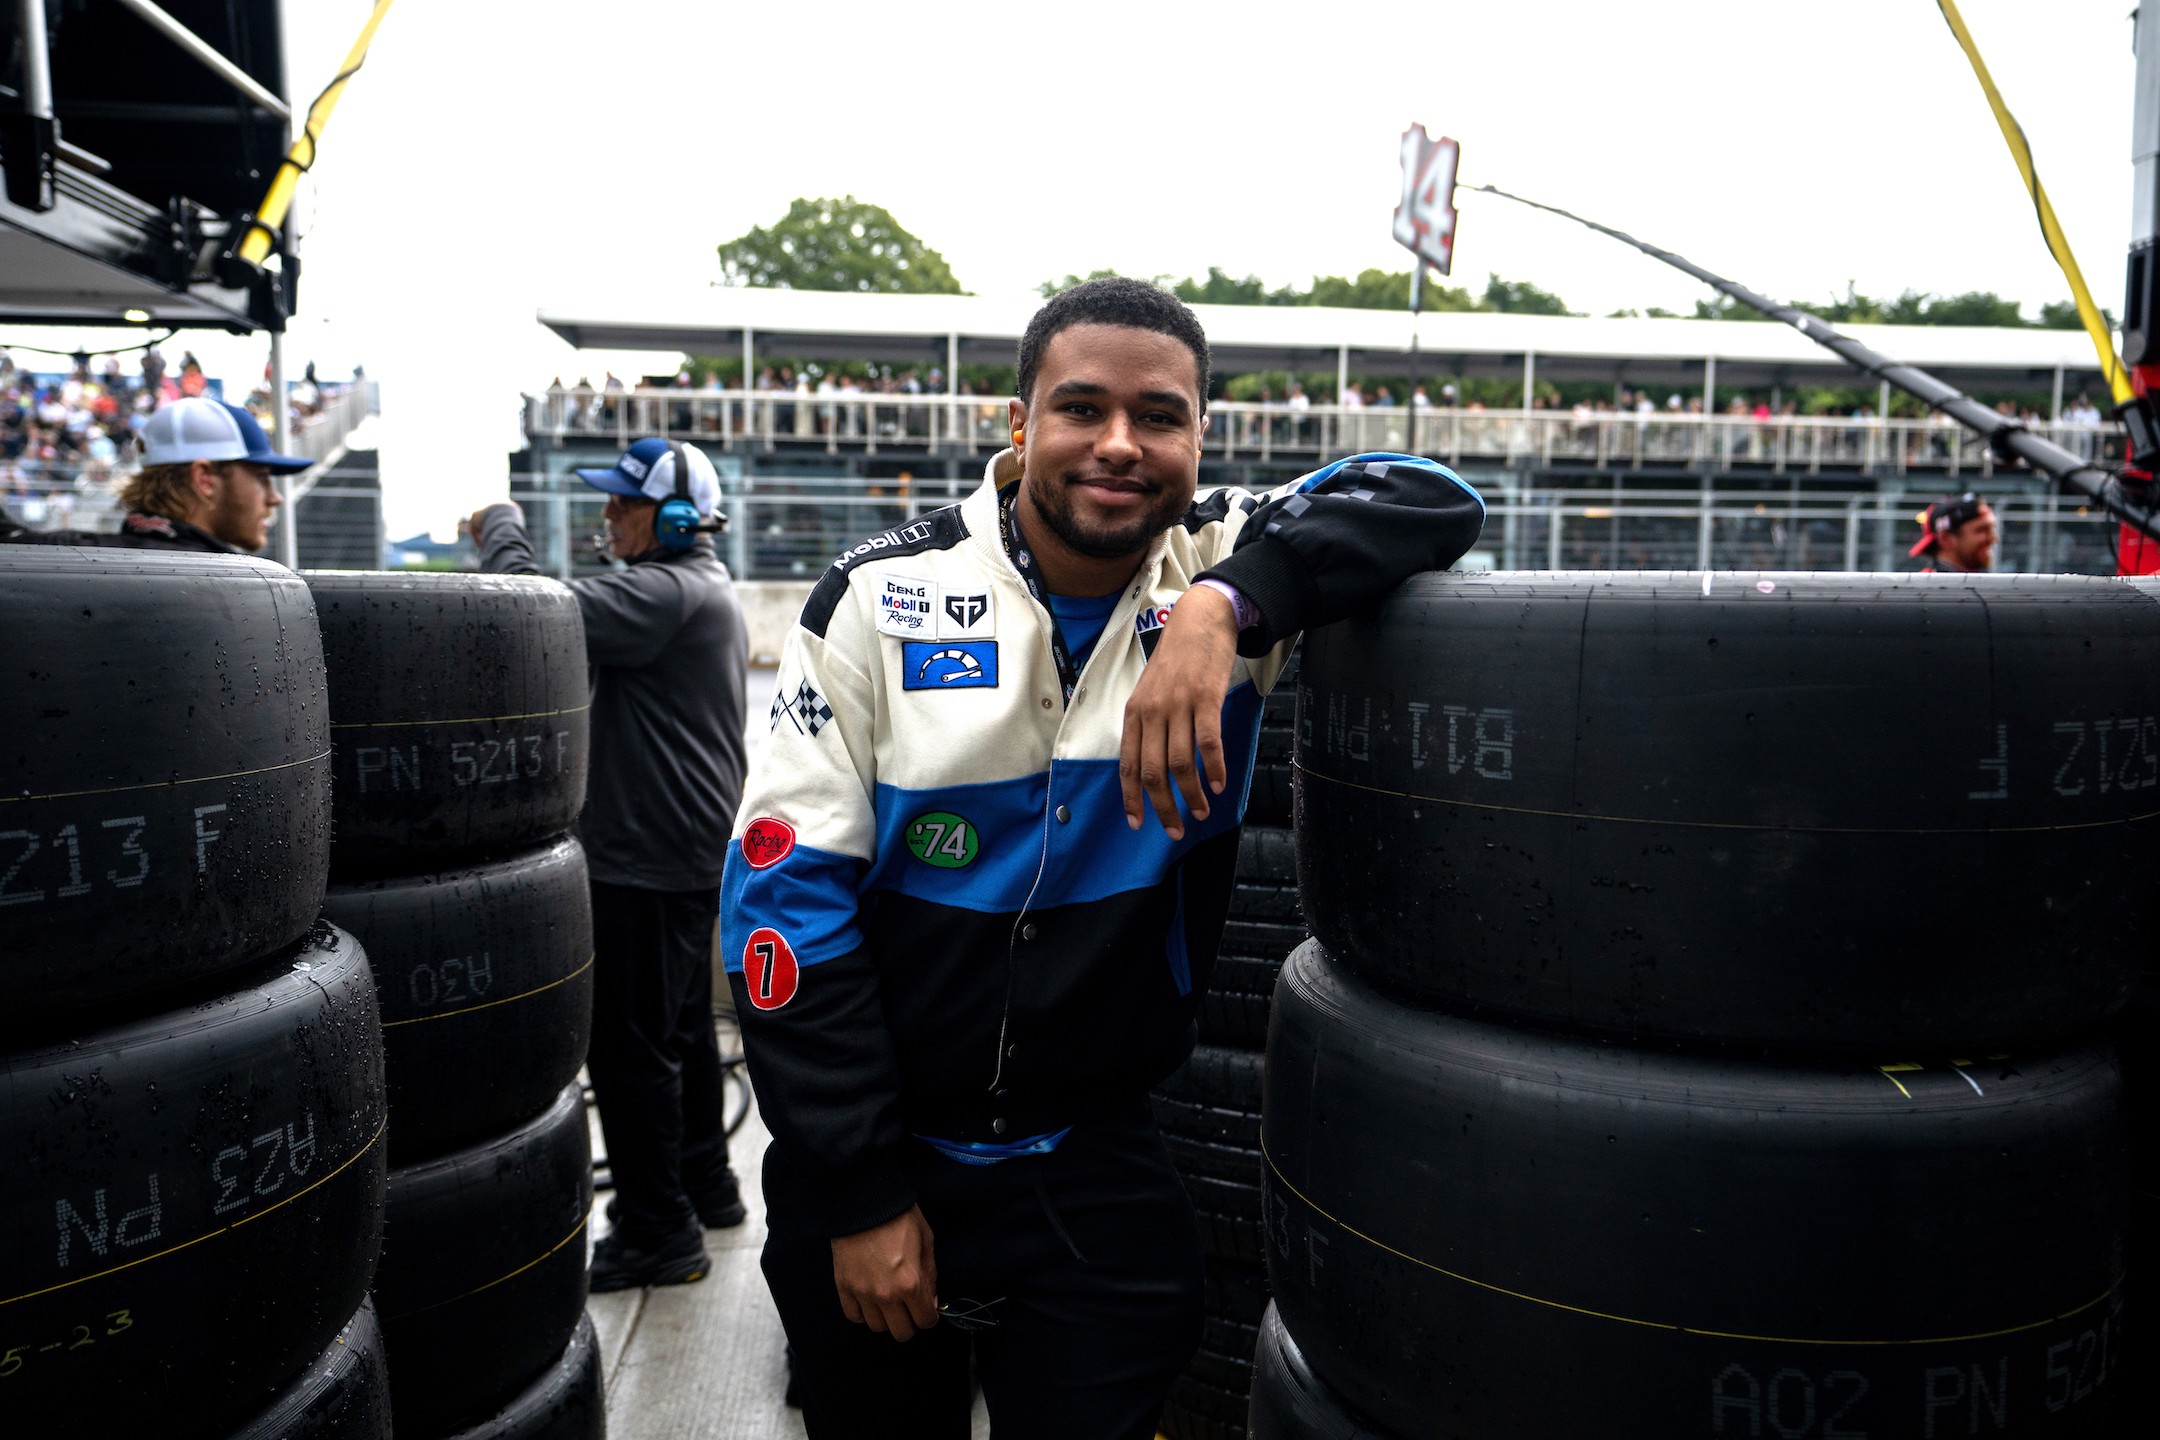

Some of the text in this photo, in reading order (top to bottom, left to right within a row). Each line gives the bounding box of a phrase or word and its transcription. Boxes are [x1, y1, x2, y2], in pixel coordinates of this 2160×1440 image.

[1394, 123, 1458, 274] 14
[886, 610, 923, 628] Racing
[919, 602, 929, 613] 1
[1136, 602, 1176, 632] Mo
[356, 731, 569, 794] PN 5213 F
[1408, 701, 1513, 780] B11
[194, 804, 227, 874] F
[915, 823, 968, 860] '74
[409, 953, 492, 1007] A30
[754, 941, 775, 999] 7
[55, 1113, 316, 1268] A23 PN
[1712, 1363, 1868, 1438] A02
[1925, 1357, 2008, 1438] PN
